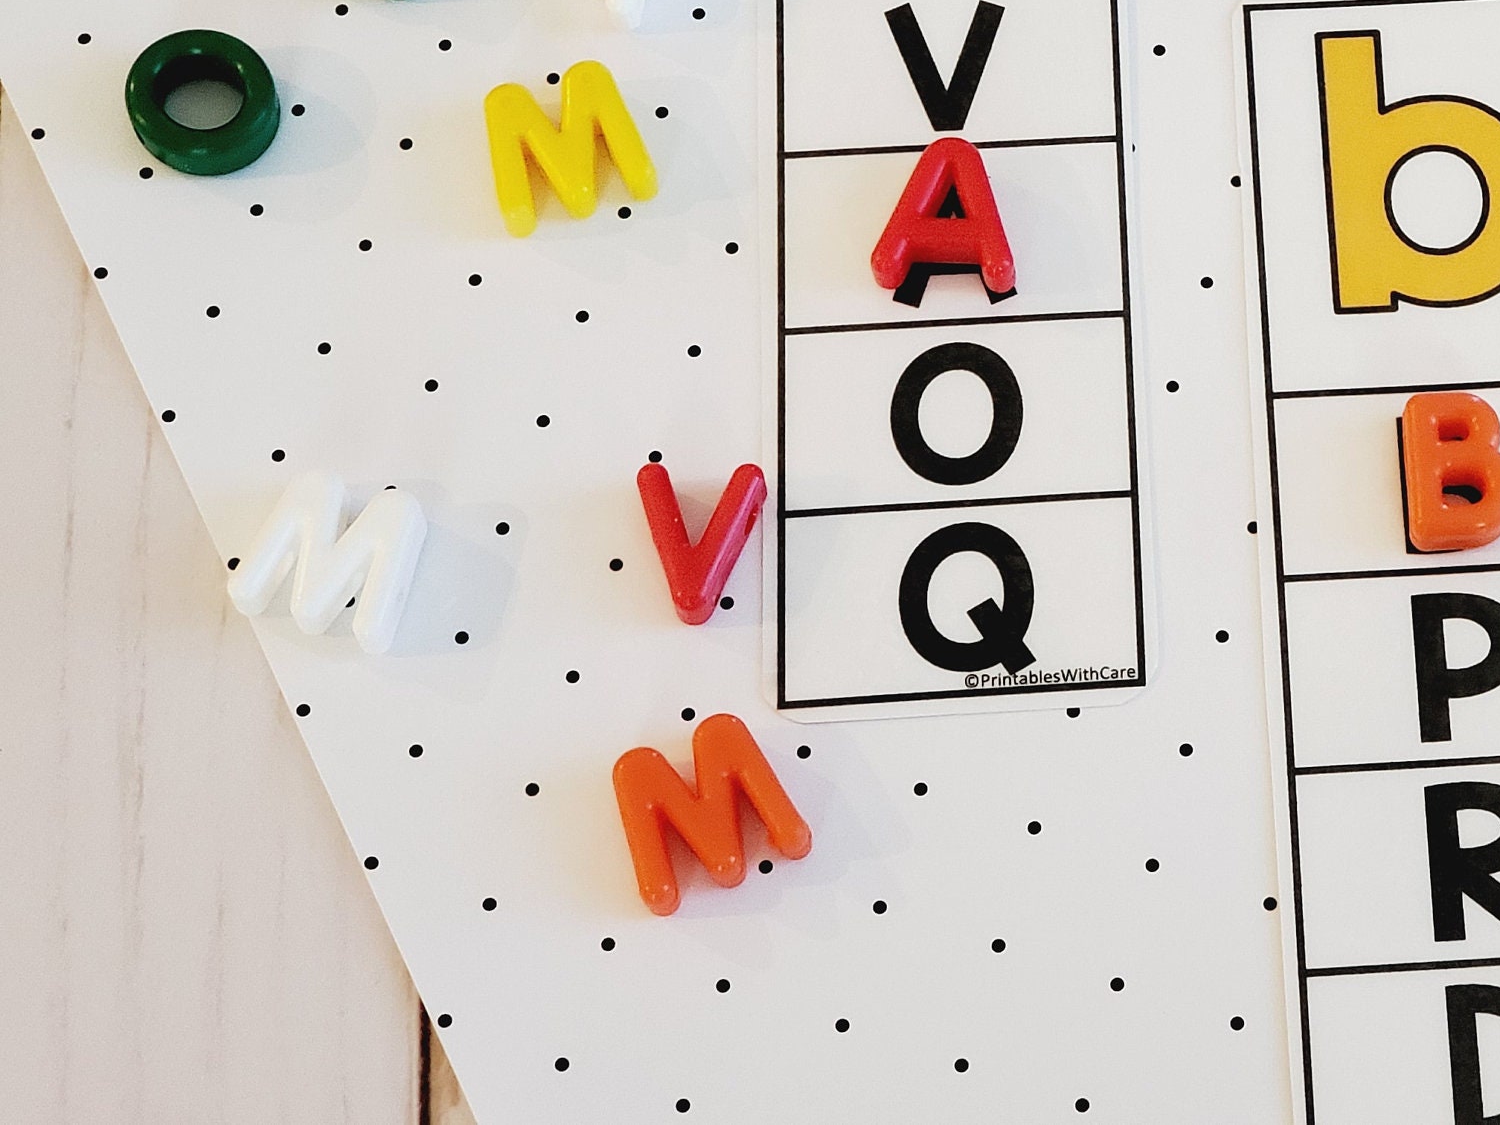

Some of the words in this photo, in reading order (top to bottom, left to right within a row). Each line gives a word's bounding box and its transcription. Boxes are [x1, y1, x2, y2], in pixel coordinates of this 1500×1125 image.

[125, 29, 281, 176] O
[884, 0, 1006, 132] V
[484, 60, 658, 238] M
[890, 341, 1024, 485] O
[227, 473, 427, 654] M
[637, 464, 767, 625] V
[898, 521, 1037, 676] Q
[612, 714, 812, 917] M
